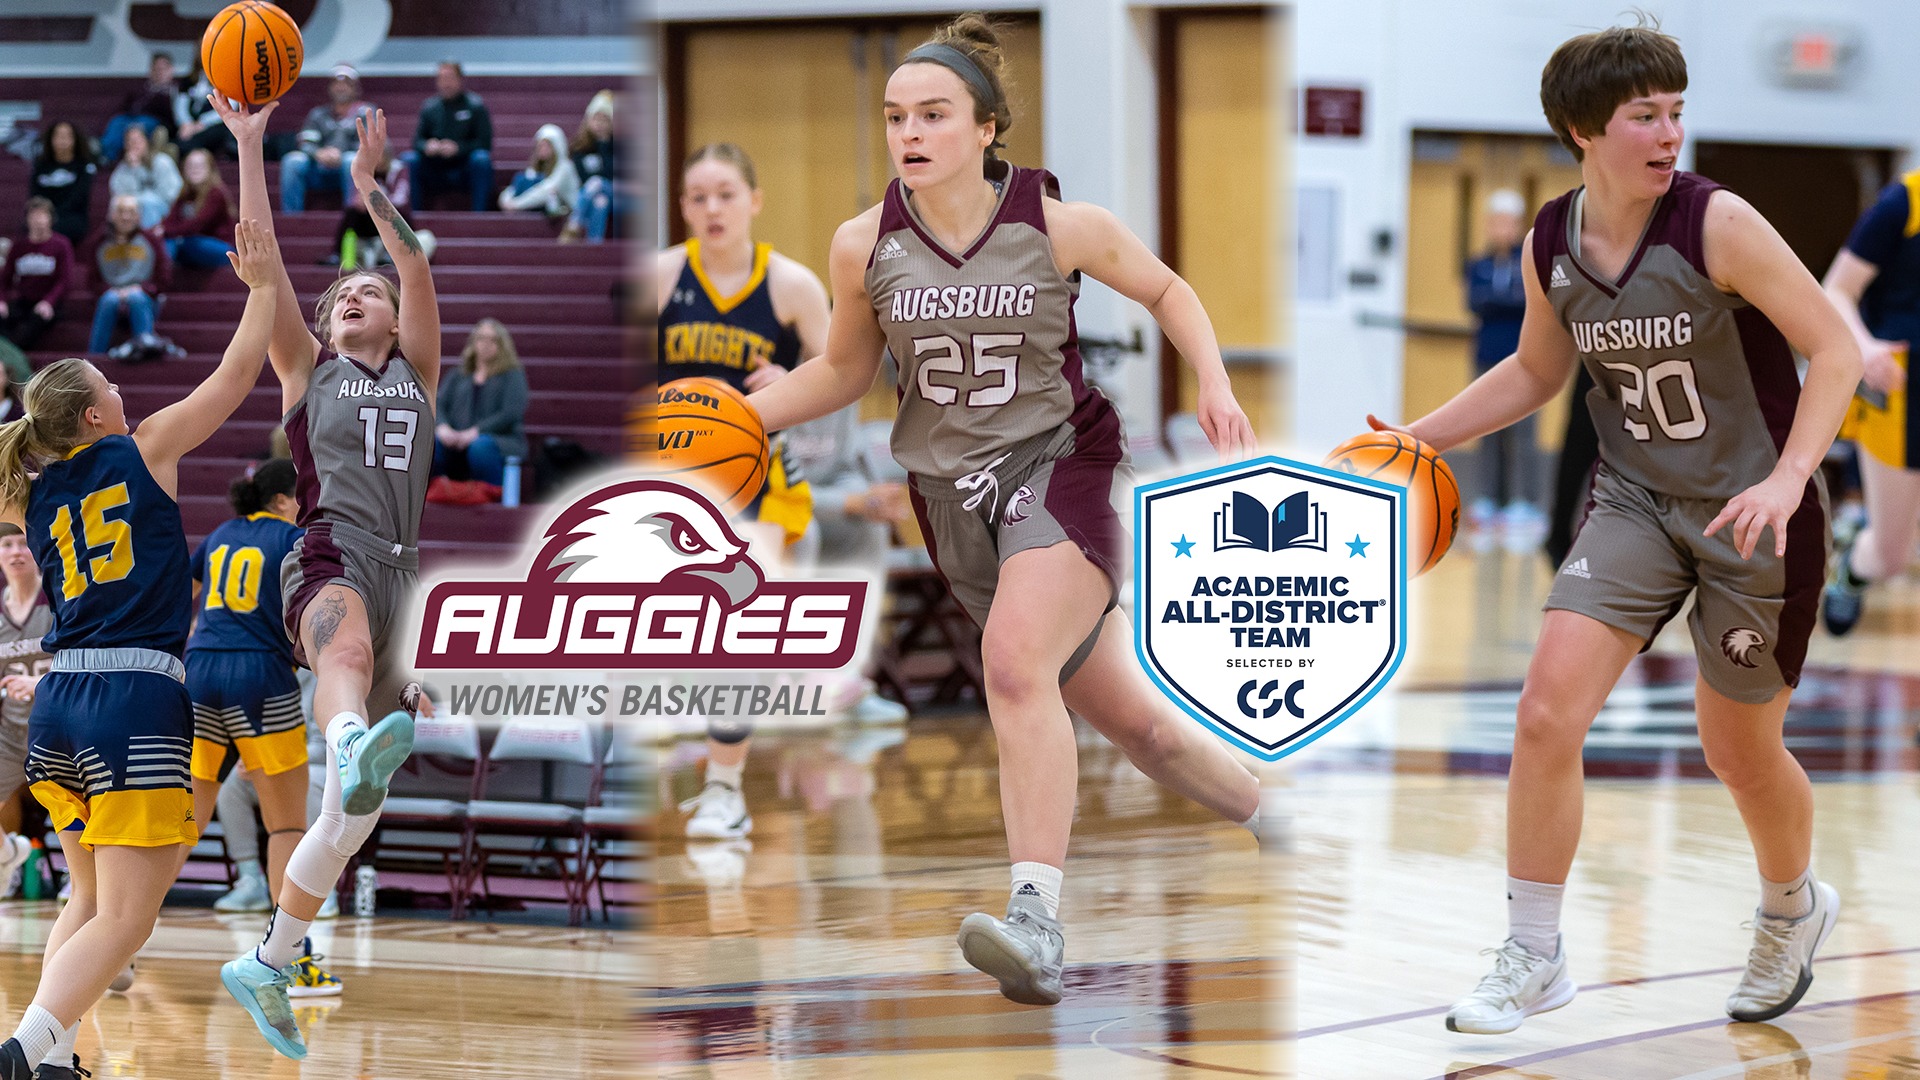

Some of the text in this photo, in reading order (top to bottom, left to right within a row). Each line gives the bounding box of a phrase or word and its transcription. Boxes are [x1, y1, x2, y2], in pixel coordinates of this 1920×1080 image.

[252, 37, 271, 100] Wilson
[877, 249, 908, 262] adidas
[1551, 279, 1571, 288] didas
[890, 283, 1036, 323] AUGSBURG
[911, 332, 1025, 407] 25
[336, 378, 426, 404] AUGSBUR
[658, 387, 720, 410] lson
[1595, 358, 1709, 442] 20
[357, 406, 419, 473] 13
[658, 430, 695, 451] VO
[49, 481, 136, 602] 15
[204, 544, 266, 614] 10
[1562, 568, 1591, 579] adidas
[1017, 889, 1041, 897] adidas
